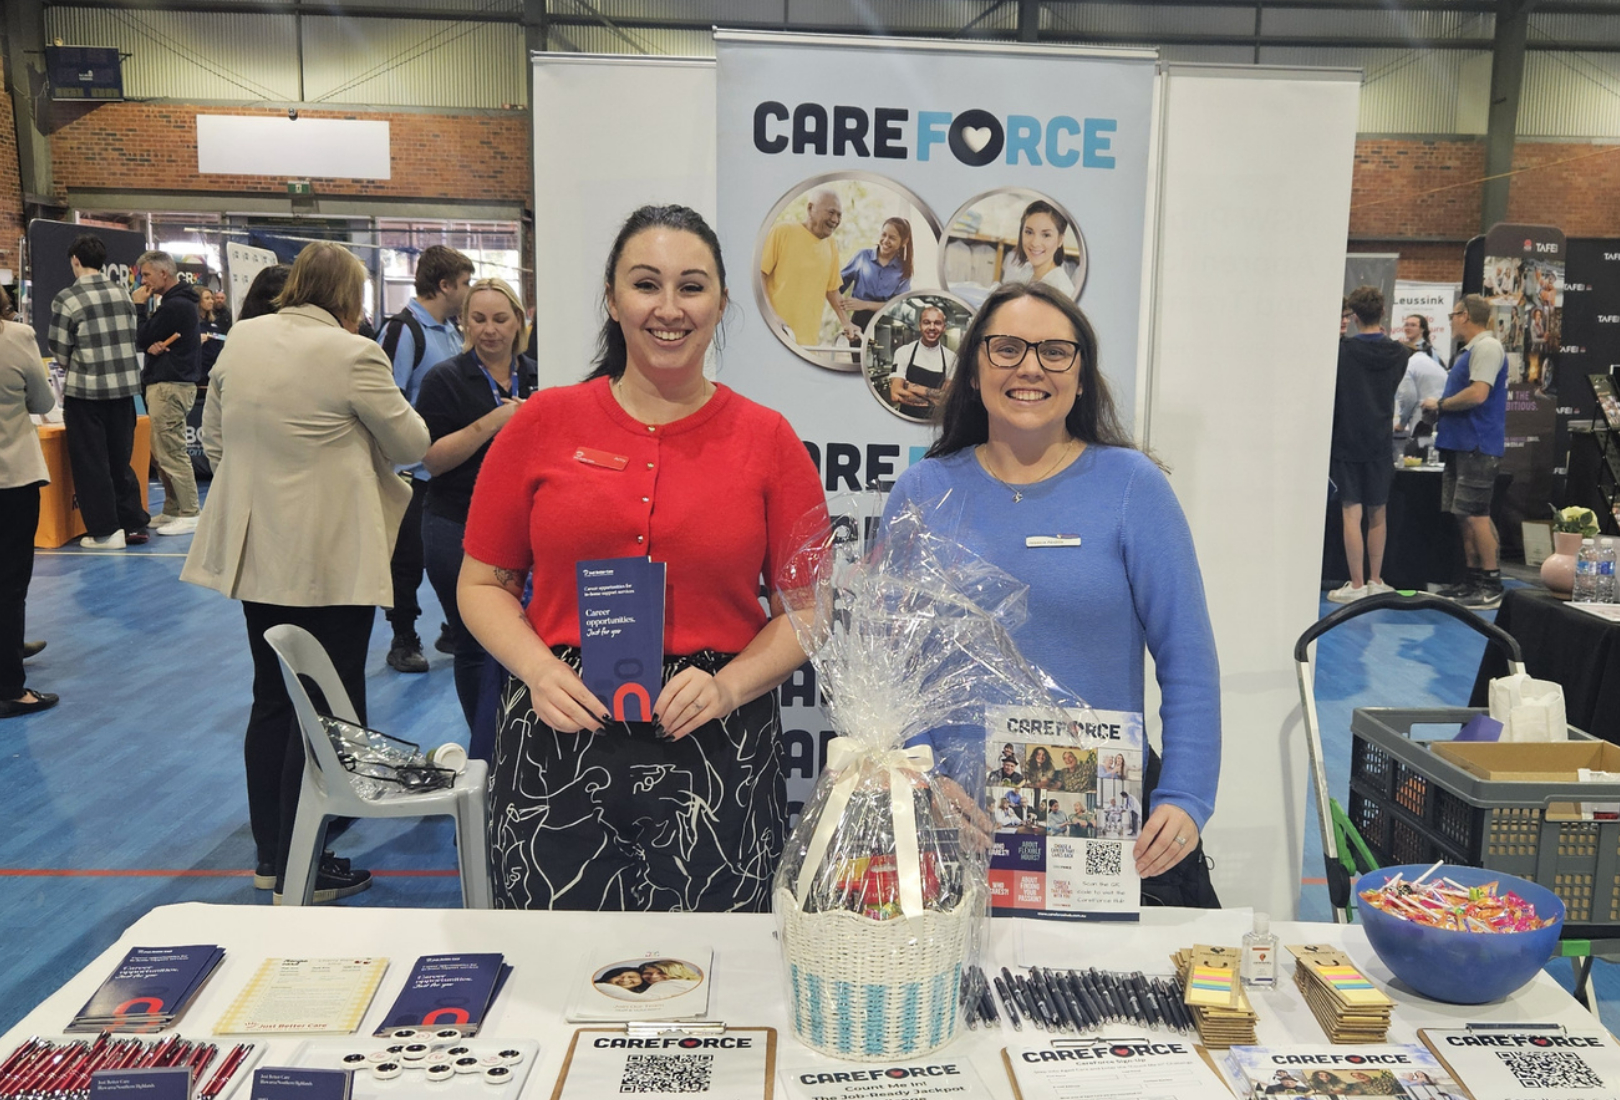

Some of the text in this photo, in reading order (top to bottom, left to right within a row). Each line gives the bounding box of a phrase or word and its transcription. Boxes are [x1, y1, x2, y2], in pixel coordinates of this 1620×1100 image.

[585, 608, 611, 617] Career
[586, 616, 636, 628] opportunities.
[586, 628, 600, 637] Just
[601, 627, 610, 636] for
[594, 1037, 752, 1049] CAREFORCE
[1022, 1043, 1188, 1063] CAREFORCE
[1271, 1053, 1412, 1065] CAREFORCE
[800, 1064, 961, 1085] CAREFORCE
[841, 1089, 910, 1100] Job-Ready
[914, 1085, 966, 1094] Jackpot
[845, 1084, 884, 1092] Count
